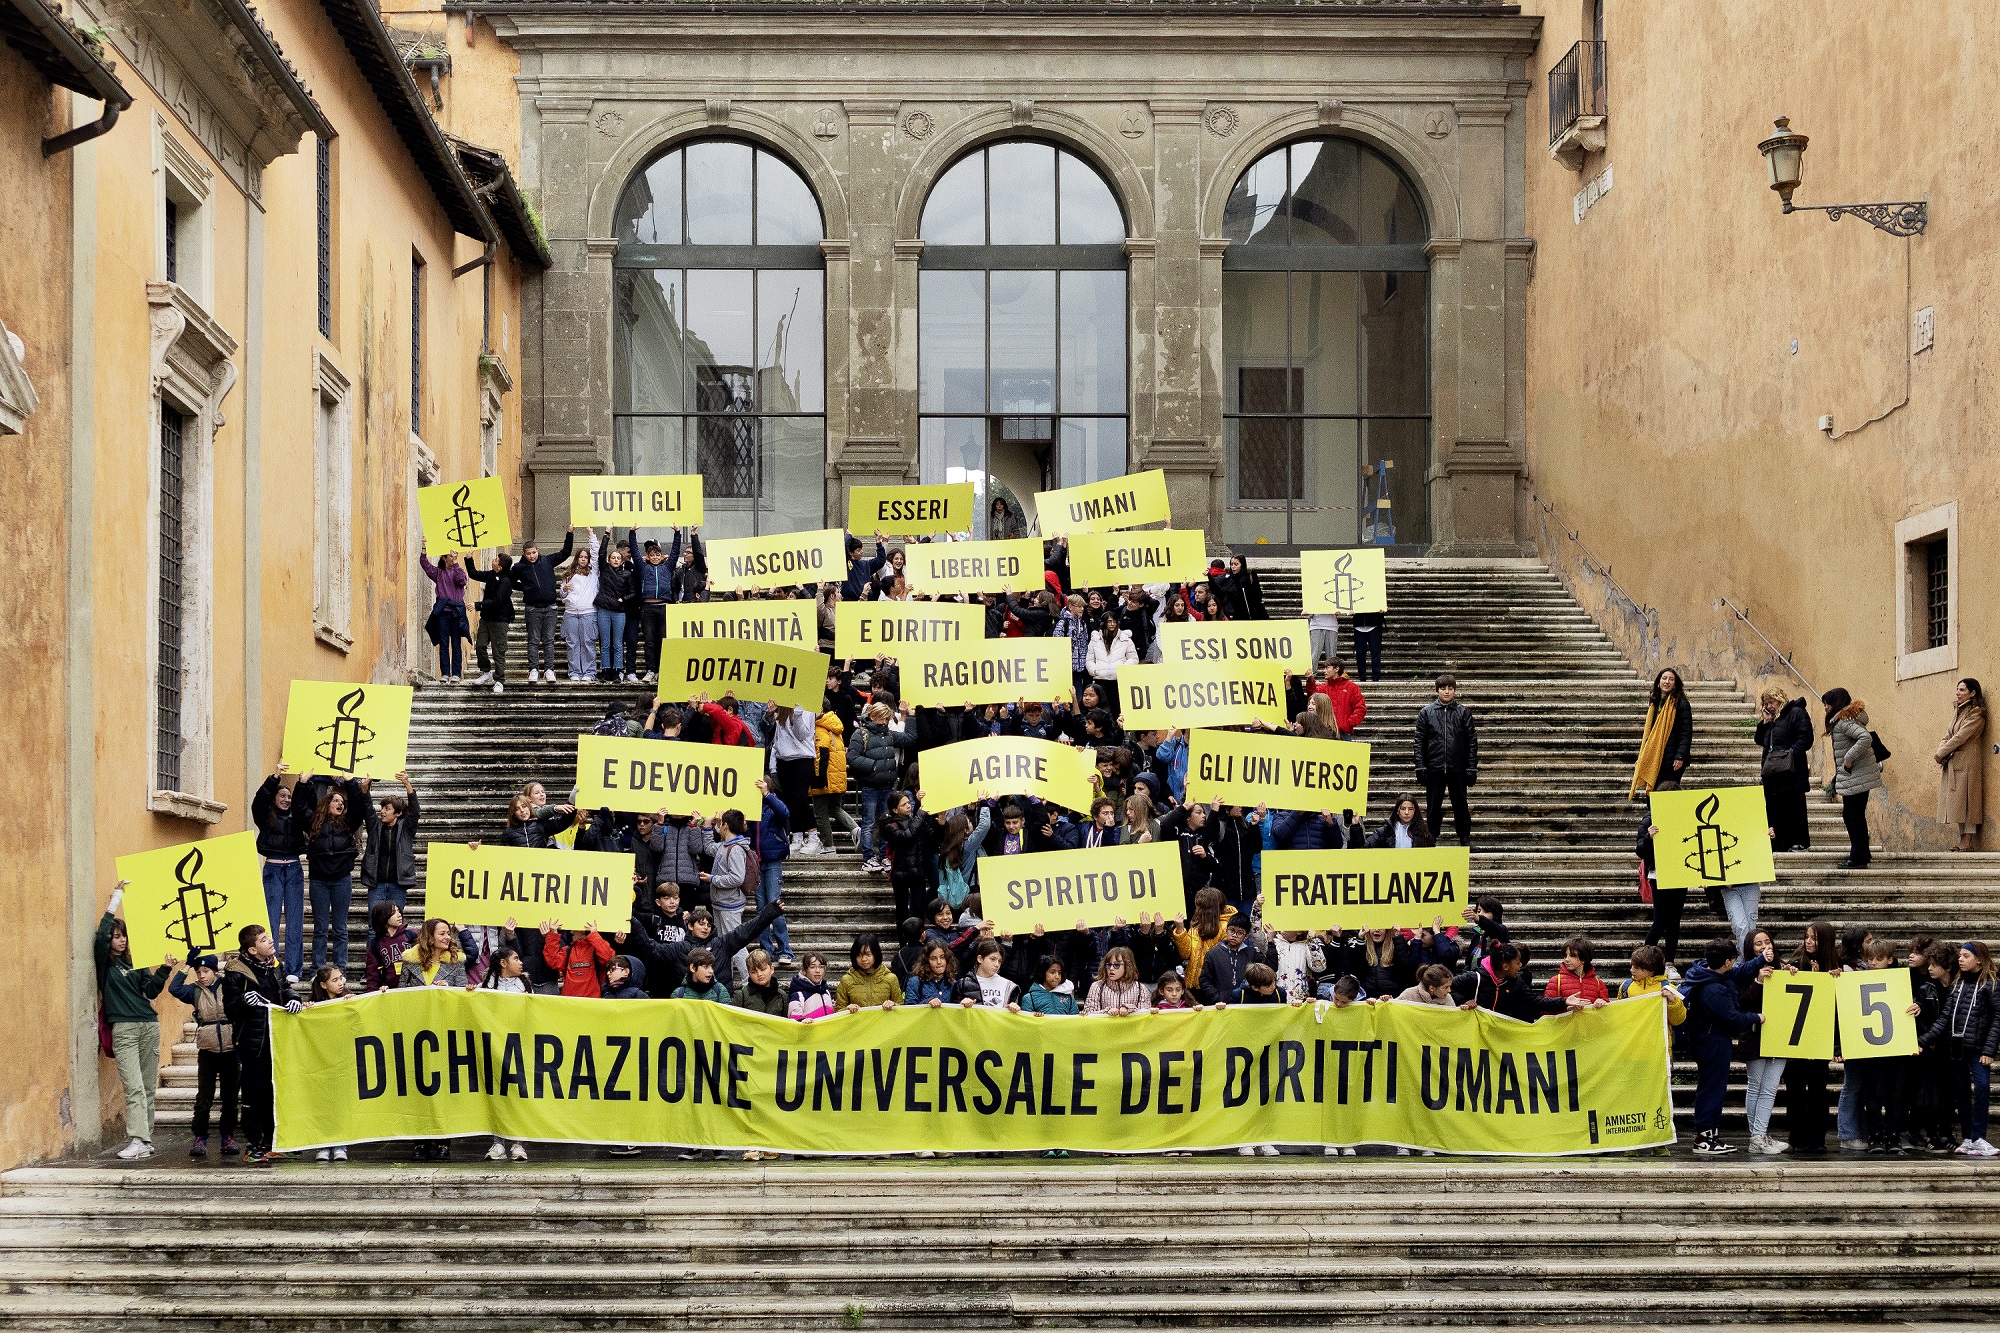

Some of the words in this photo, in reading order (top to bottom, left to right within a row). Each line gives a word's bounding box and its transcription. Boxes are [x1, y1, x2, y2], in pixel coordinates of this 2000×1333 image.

[591, 491, 642, 511] TUTTI
[652, 491, 680, 511] GLI
[878, 499, 948, 520] ESSERI
[1070, 491, 1136, 522] UMANI
[731, 549, 822, 576] NASCONO
[931, 558, 989, 578] LIBERI
[997, 557, 1019, 576] ED
[1106, 548, 1171, 569] EGUALI
[683, 621, 703, 637] IN
[714, 612, 802, 641] DIGNITÀ
[861, 620, 871, 642] E
[882, 619, 959, 640] DIRITTI
[1181, 638, 1227, 660] ESSI
[1236, 637, 1292, 659] SONO
[687, 658, 764, 683] DOTATI
[773, 664, 797, 689] DI
[924, 659, 1025, 687] RAGIONE
[1037, 659, 1048, 682] E
[1131, 686, 1151, 709] DI
[1165, 681, 1277, 709] COSCIENZA
[603, 759, 618, 788] E
[630, 761, 737, 797] DEVONO
[969, 755, 1047, 784] AGIRE
[1200, 753, 1233, 782] GLI
[1243, 756, 1280, 785] UNI
[1292, 760, 1357, 792] VERSO
[451, 869, 488, 899] GLI
[500, 872, 570, 904] ALTRI
[581, 876, 608, 906] IN
[1008, 872, 1118, 910] SPIRITO
[1129, 869, 1156, 899] DI
[1276, 872, 1454, 906] FRATELLANZA
[1786, 984, 1813, 1046] 7
[1860, 983, 1893, 1045] 5
[355, 1030, 753, 1110] DICHIARAZIONE
[775, 1047, 1098, 1115] UNIVERSALE
[1120, 1050, 1202, 1115] DEI
[1223, 1039, 1397, 1108] DIRITTI
[1421, 1045, 1579, 1114] UMANI
[1605, 1125, 1647, 1135] INTERNATIONAL
[1606, 1112, 1647, 1127] AMNESTY
